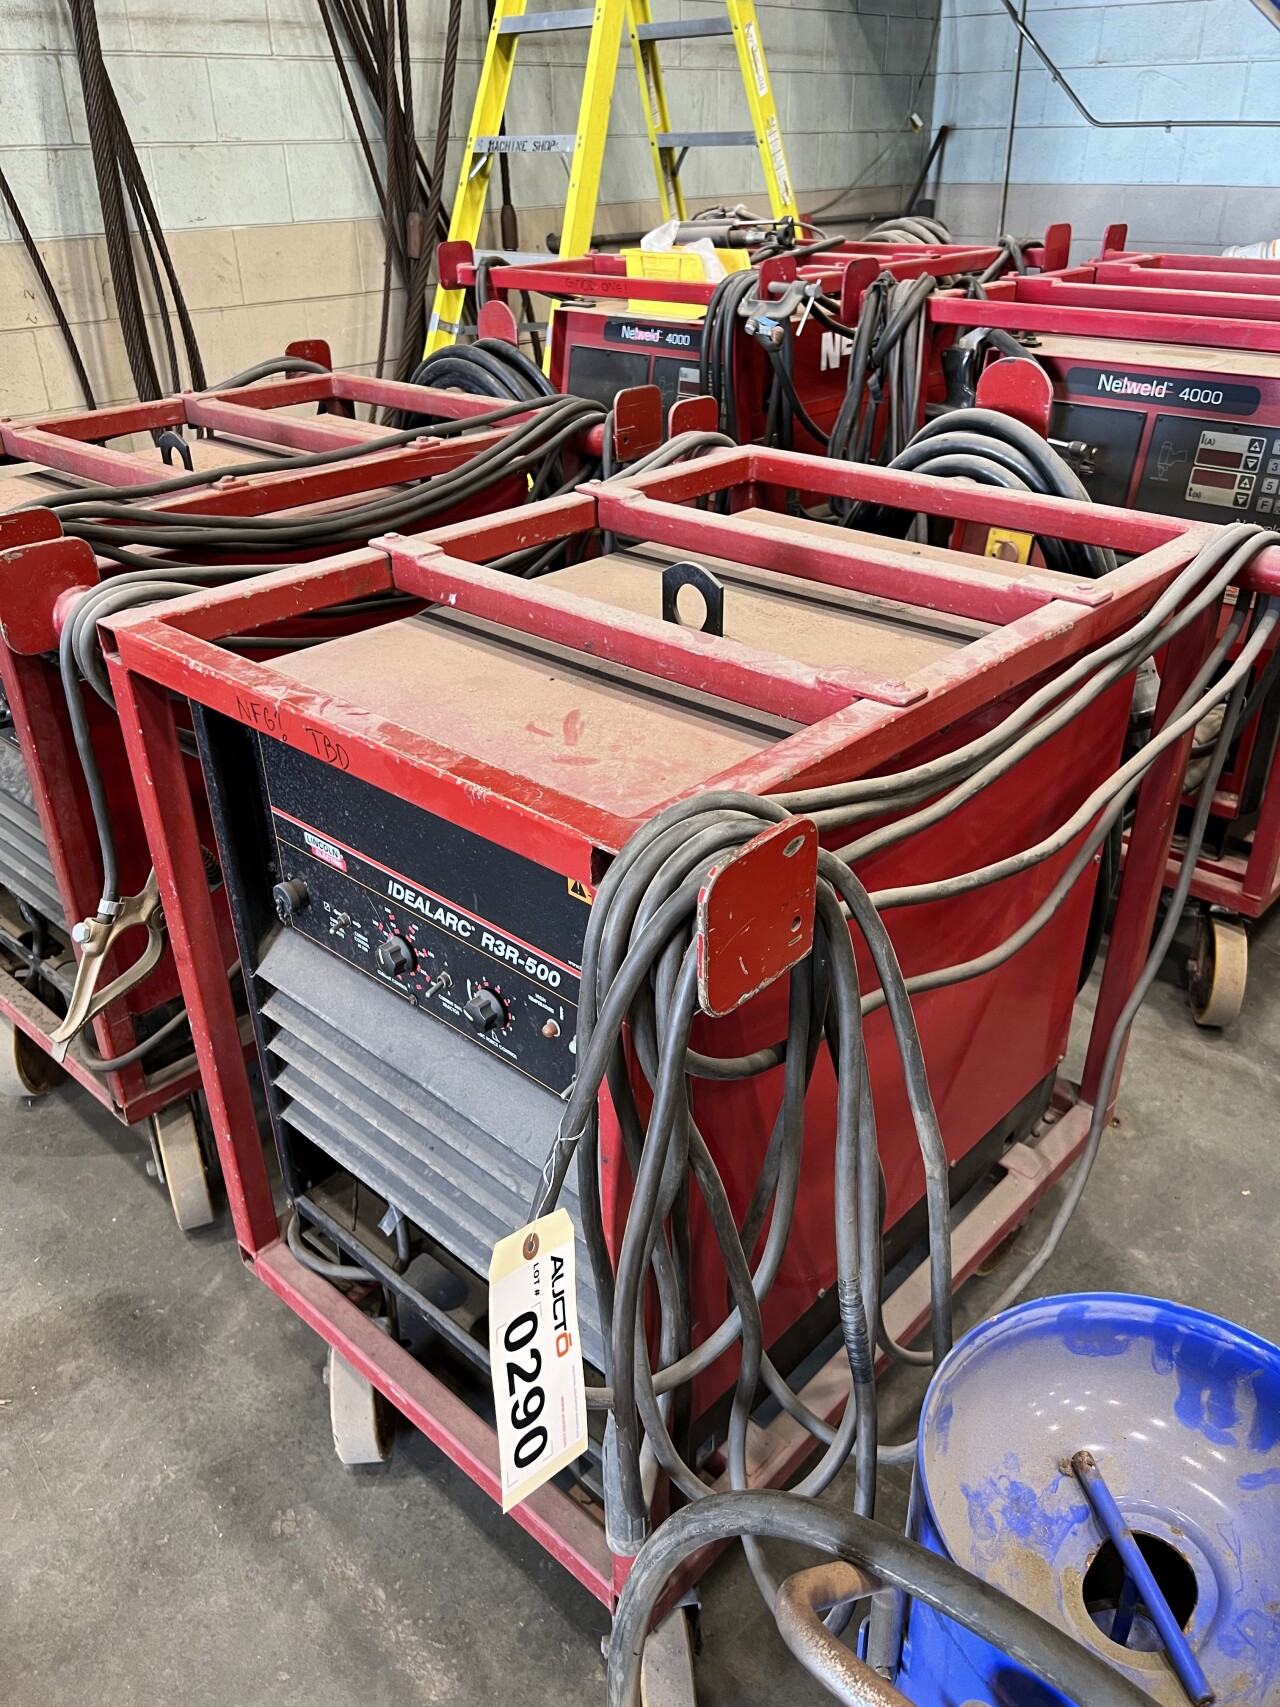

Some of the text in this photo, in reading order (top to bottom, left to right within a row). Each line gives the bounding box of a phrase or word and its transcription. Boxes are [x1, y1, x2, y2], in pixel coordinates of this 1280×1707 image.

[532, 140, 556, 152] SHOP
[666, 333, 691, 346] 4000
[1178, 387, 1223, 405] 4000
[1271, 462, 1279, 472] 3
[1266, 481, 1274, 491] 5
[1260, 500, 1269, 510] F
[305, 727, 350, 770] TBD
[305, 833, 341, 859] LINCOLN
[387, 880, 472, 938] IDEALARC
[480, 931, 561, 988] R3R-500
[532, 1262, 540, 1297] LOT #
[503, 1310, 548, 1469] 0290
